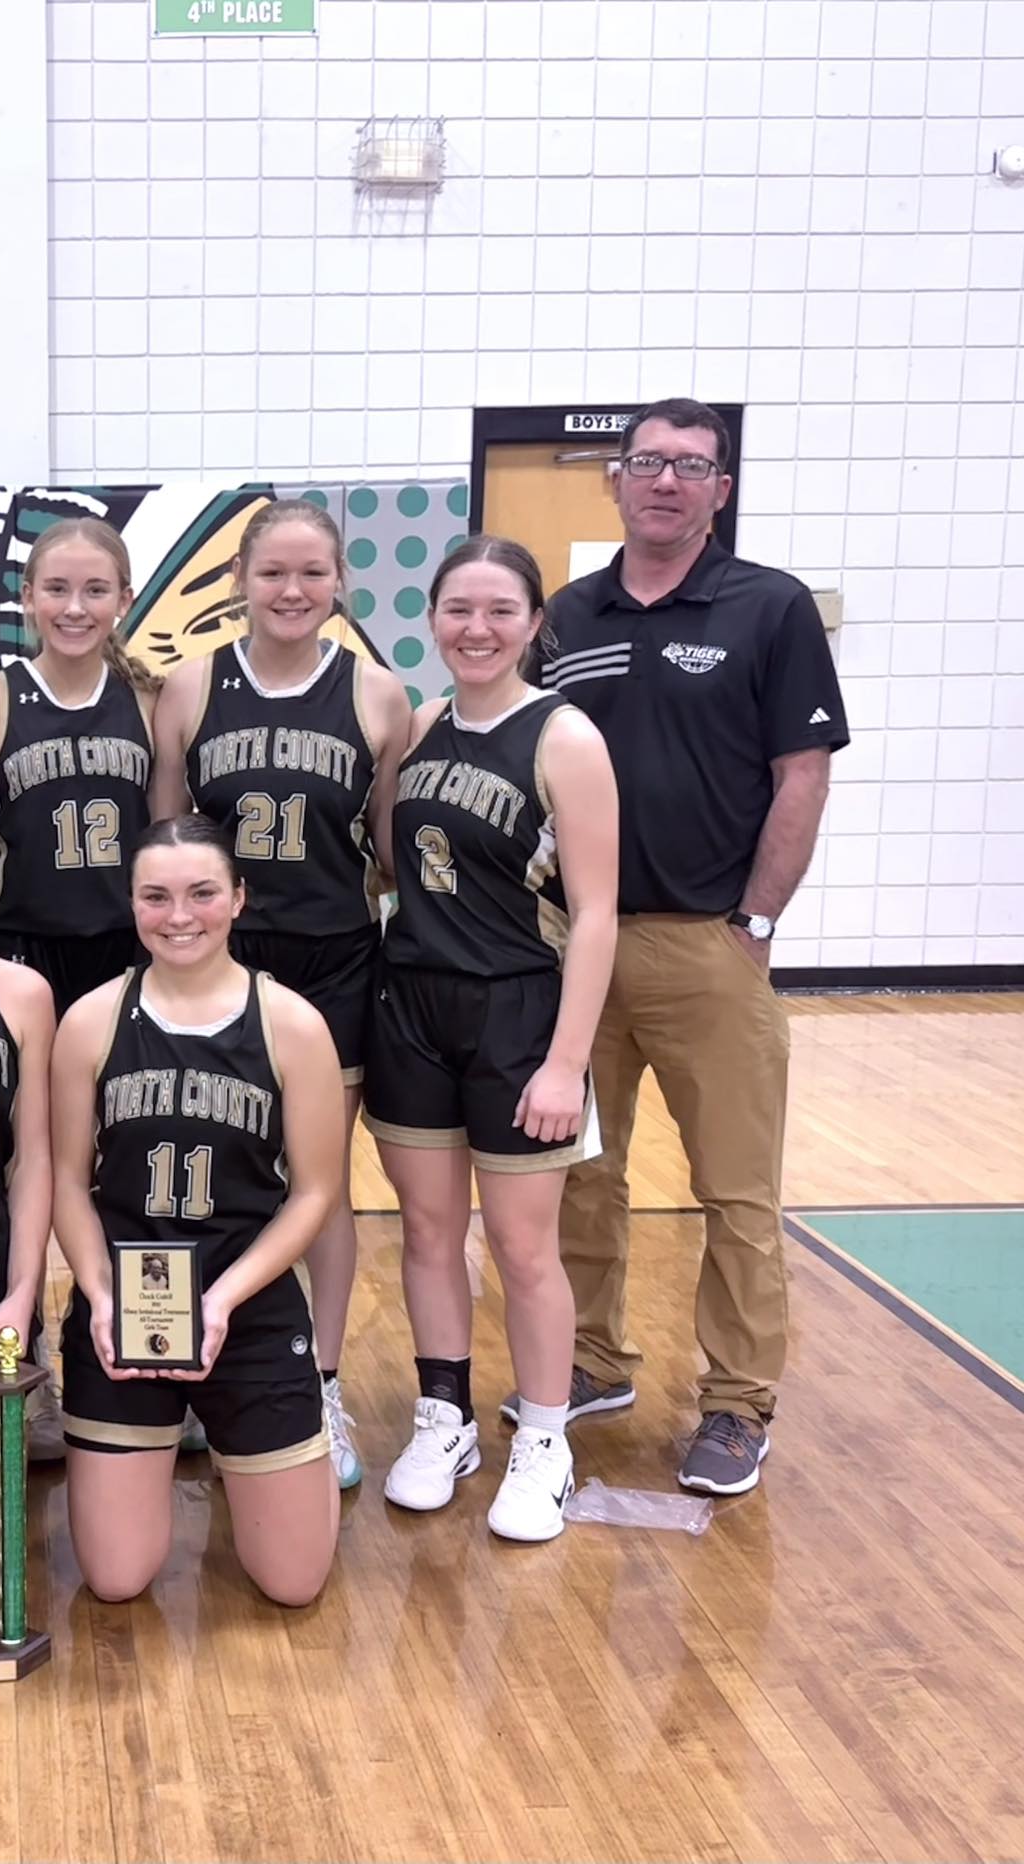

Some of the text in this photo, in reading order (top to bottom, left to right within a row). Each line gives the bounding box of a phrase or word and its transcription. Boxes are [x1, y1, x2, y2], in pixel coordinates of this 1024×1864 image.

[187, 0, 283, 23] 4TH PLACE
[572, 415, 613, 429] BOYS
[685, 647, 727, 661] TIGER
[3, 736, 76, 802] NORTH
[199, 726, 358, 792] NORTH COUNTY
[52, 798, 122, 870] 12
[235, 792, 307, 862] 21
[438, 760, 527, 838] COUNTY
[414, 824, 457, 894] 2
[104, 1068, 273, 1140] NORTH COUNTY
[144, 1141, 215, 1221] 11
